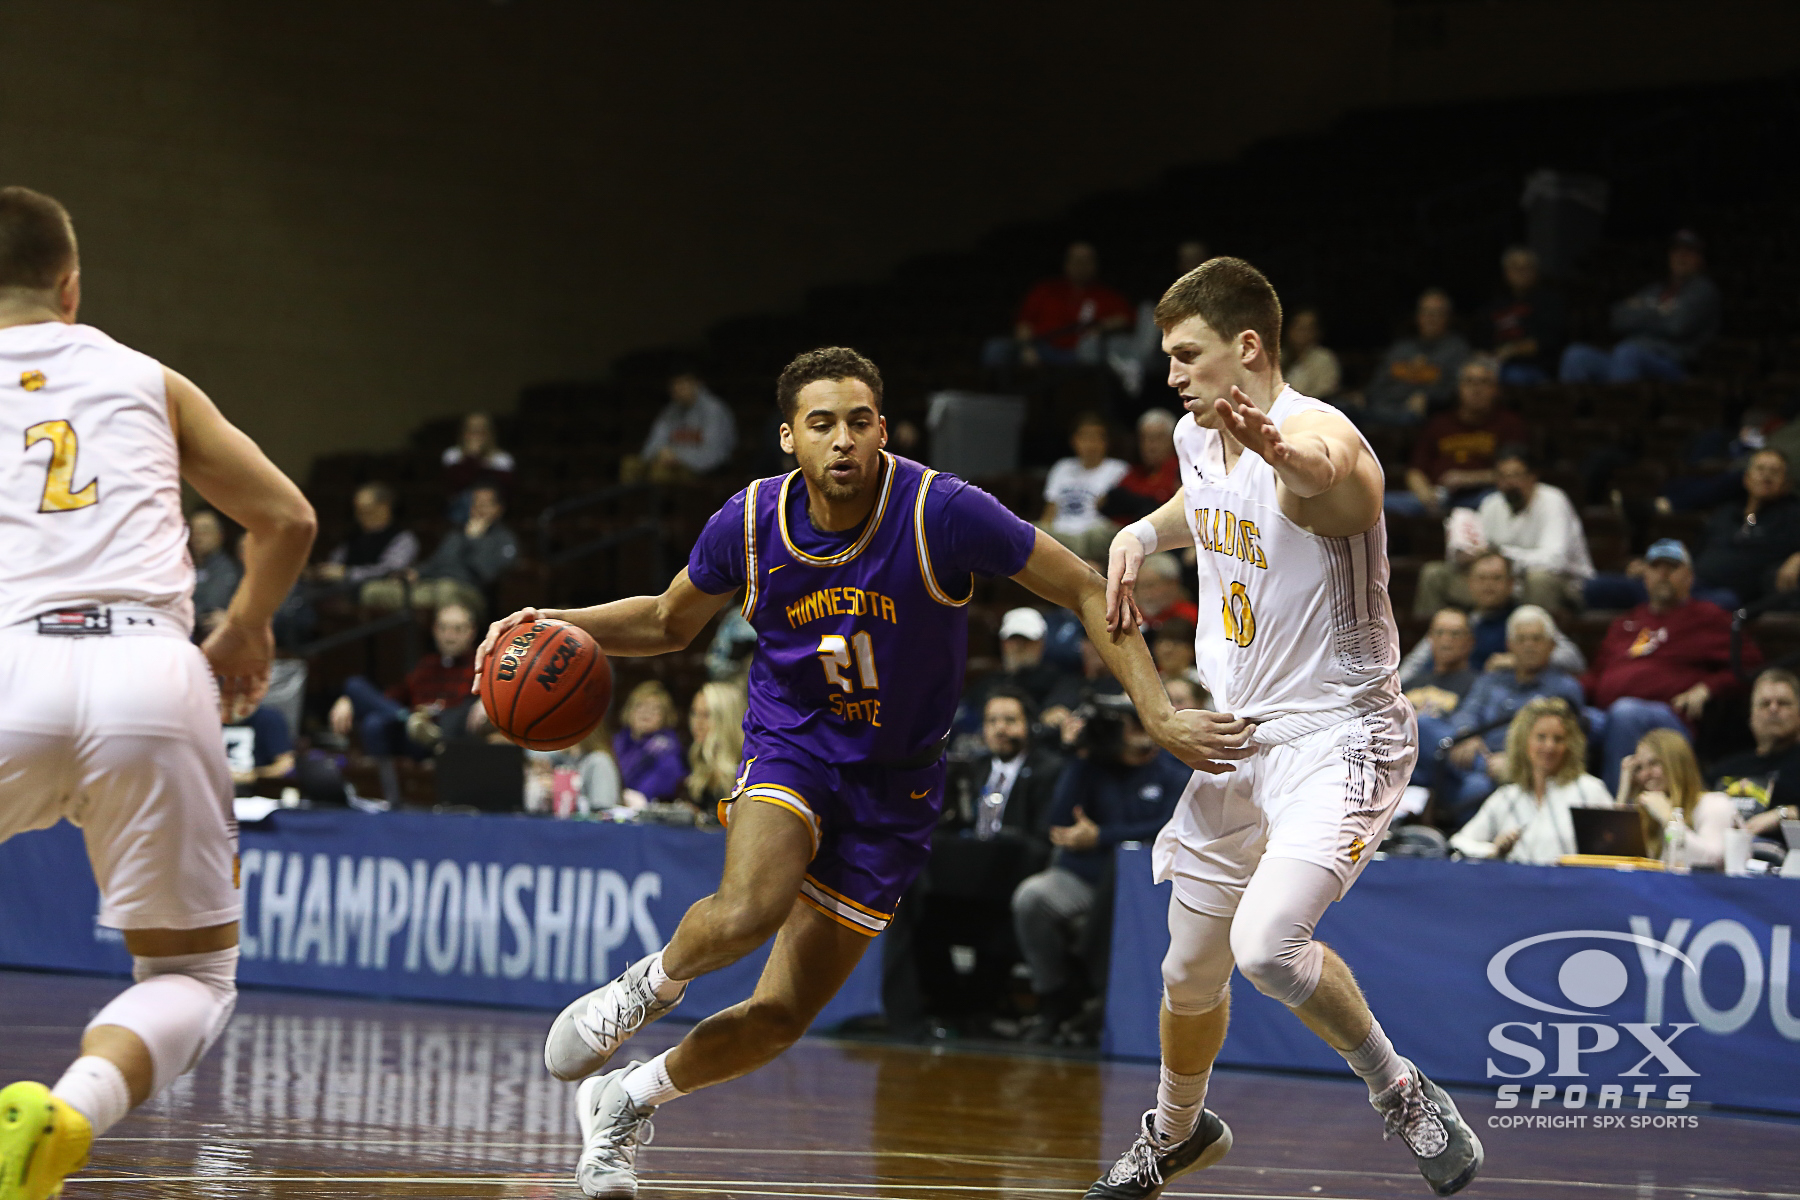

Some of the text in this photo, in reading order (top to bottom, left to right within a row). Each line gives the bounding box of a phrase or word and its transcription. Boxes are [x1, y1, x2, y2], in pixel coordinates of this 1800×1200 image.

[24, 419, 98, 514] 2
[785, 586, 898, 629] MINNESOTA
[535, 635, 582, 692] NCAA
[816, 629, 879, 693] 21
[238, 847, 662, 985] CHAMPIONSHIPS
